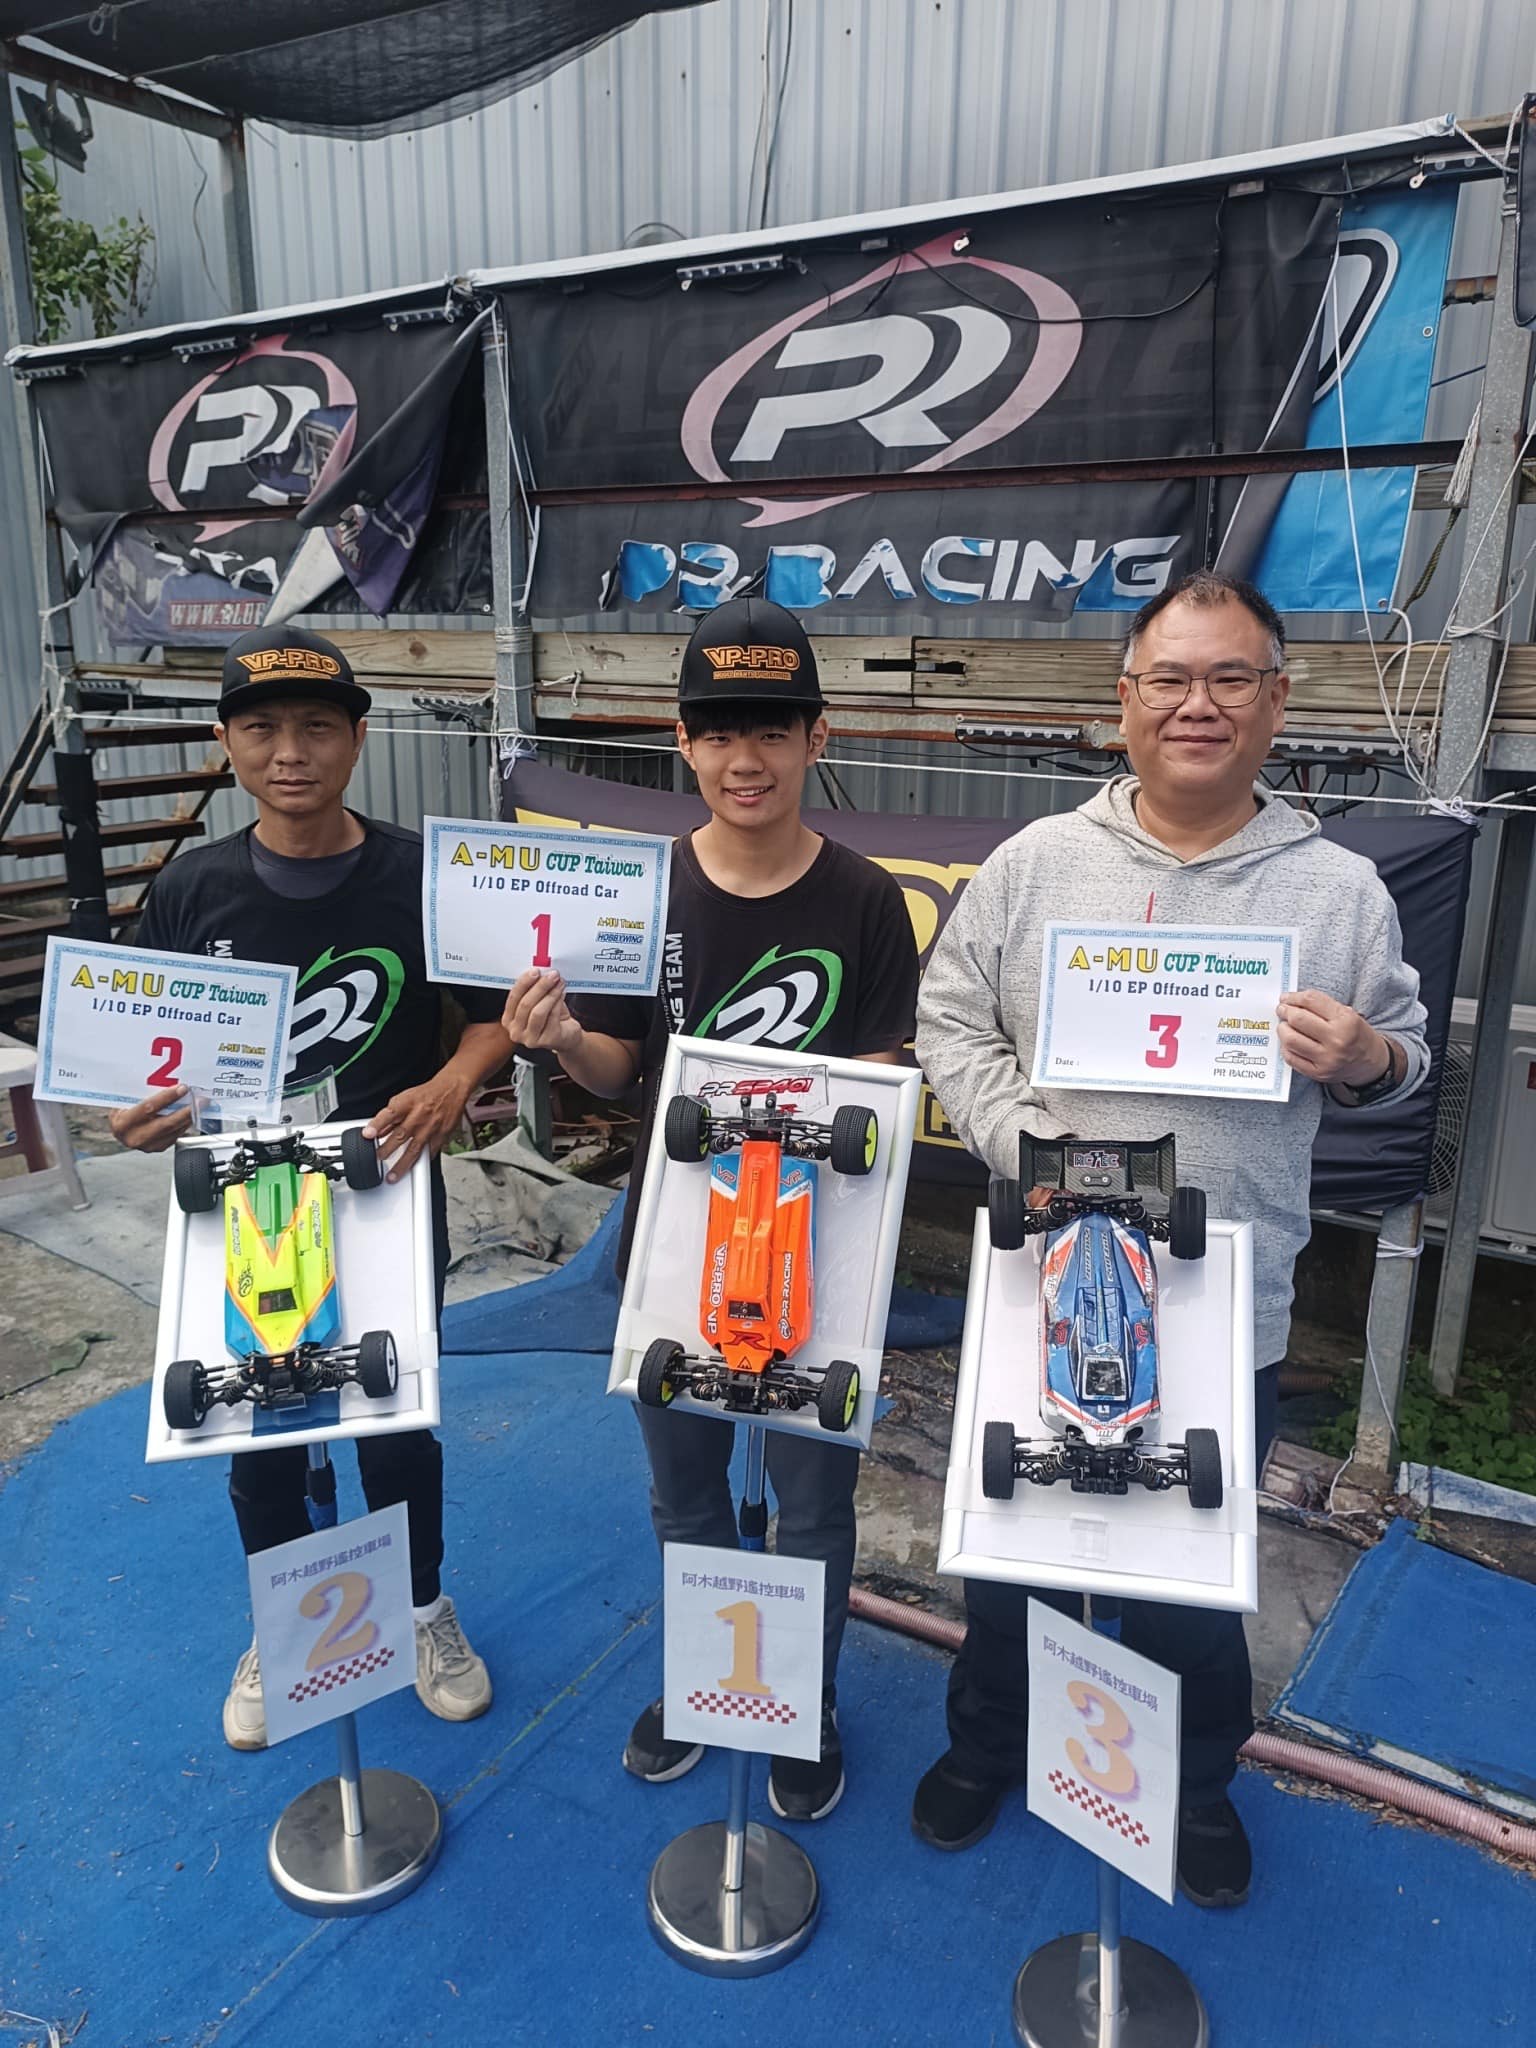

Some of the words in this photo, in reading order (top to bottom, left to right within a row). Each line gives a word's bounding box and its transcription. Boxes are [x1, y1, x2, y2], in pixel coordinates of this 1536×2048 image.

[236, 648, 341, 675] VP-PRO
[702, 645, 800, 671] VP-PRO
[451, 842, 540, 871] A-MU
[546, 852, 580, 871] CUP
[584, 854, 645, 878] Taiwan
[472, 875, 504, 890] 1/10
[511, 878, 530, 891] EP
[536, 881, 588, 897] Offroad
[594, 885, 619, 899] Car
[531, 913, 552, 967] 1
[596, 932, 644, 944] HOBBYWING
[606, 965, 639, 974] RACING
[665, 932, 684, 993] TEAM
[1068, 945, 1158, 974] A-MU
[1164, 952, 1200, 972] CUP
[1204, 954, 1269, 976] Taiwan
[71, 964, 165, 997] A-MU
[169, 979, 205, 1000] CUP
[208, 984, 269, 1006] Taiwan
[1089, 979, 1121, 993] 1/10
[1128, 982, 1147, 994] EP
[1153, 982, 1208, 997] Offroad
[1215, 985, 1241, 998] Car
[91, 997, 126, 1015] 1/10
[132, 1003, 152, 1017] EP
[157, 1005, 212, 1023] Offroad
[217, 1010, 242, 1027] Car
[1145, 1014, 1182, 1068] 3
[1216, 1033, 1270, 1047] HOBBYWING
[147, 1036, 183, 1088] 2
[1229, 1069, 1266, 1078] RACING
[709, 1242, 728, 1307] VP-PRO
[781, 1252, 792, 1298] RACING
[780, 1299, 791, 1318] PR
[299, 1571, 381, 1673] 2
[715, 1600, 776, 1698] 1
[1065, 1680, 1141, 1803] 3
